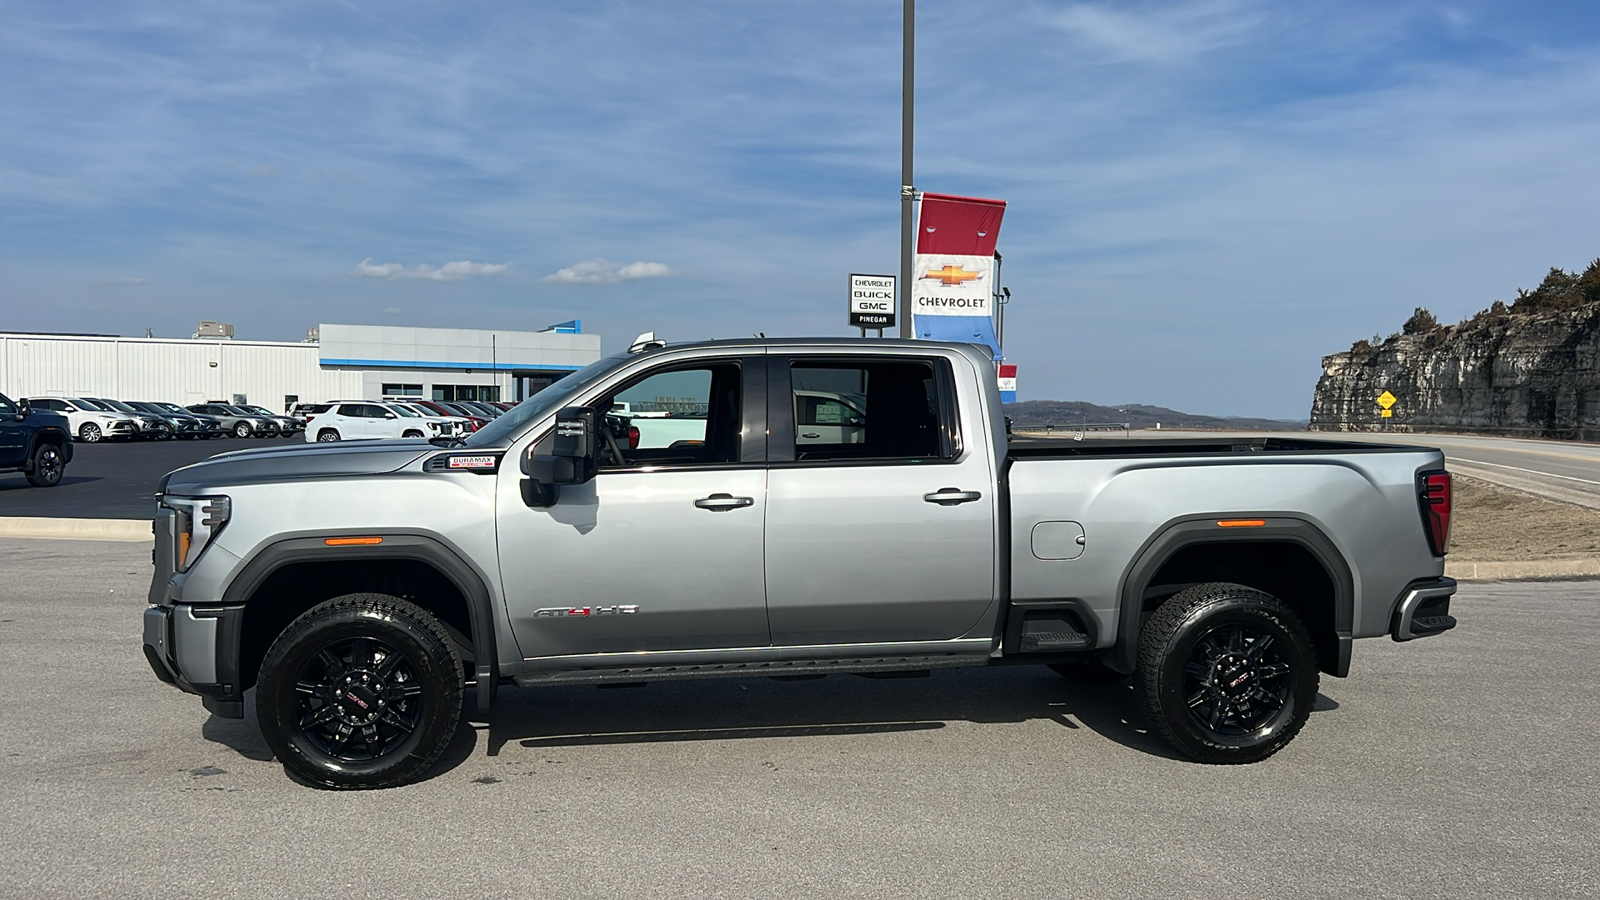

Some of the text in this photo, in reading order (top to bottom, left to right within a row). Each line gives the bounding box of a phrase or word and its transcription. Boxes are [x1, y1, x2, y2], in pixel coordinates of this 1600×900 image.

[855, 279, 892, 287] CHEVROLET
[854, 290, 892, 299] BUICK
[859, 302, 887, 310] GMC
[918, 296, 985, 308] CHEVROLET
[533, 606, 590, 618] AT4
